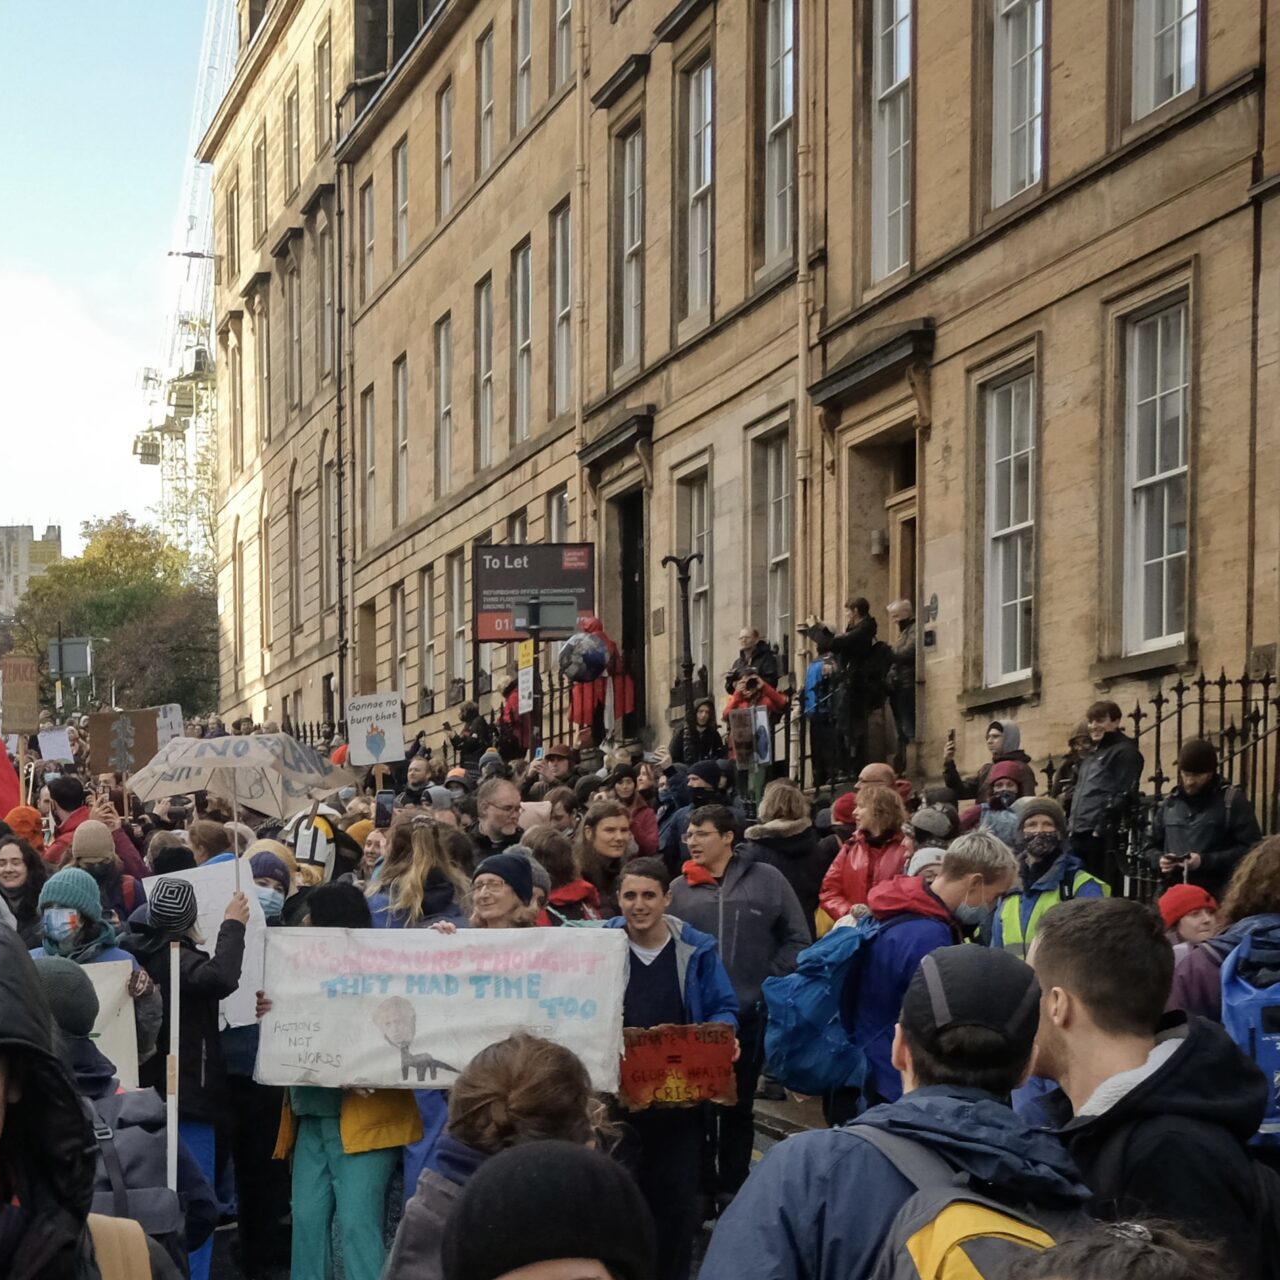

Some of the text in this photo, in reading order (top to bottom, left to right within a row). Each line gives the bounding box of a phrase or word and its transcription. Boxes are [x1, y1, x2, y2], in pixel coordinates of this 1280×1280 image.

[483, 555, 529, 569] To Let
[348, 698, 398, 713] Gonnae no
[350, 710, 398, 725] burn that
[467, 946, 606, 975] THOUGHT
[320, 973, 543, 999] THEY HAD TIME
[538, 998, 598, 1020] TOO
[288, 1036, 312, 1048] NOT
[652, 1083, 718, 1100] CRISIS
